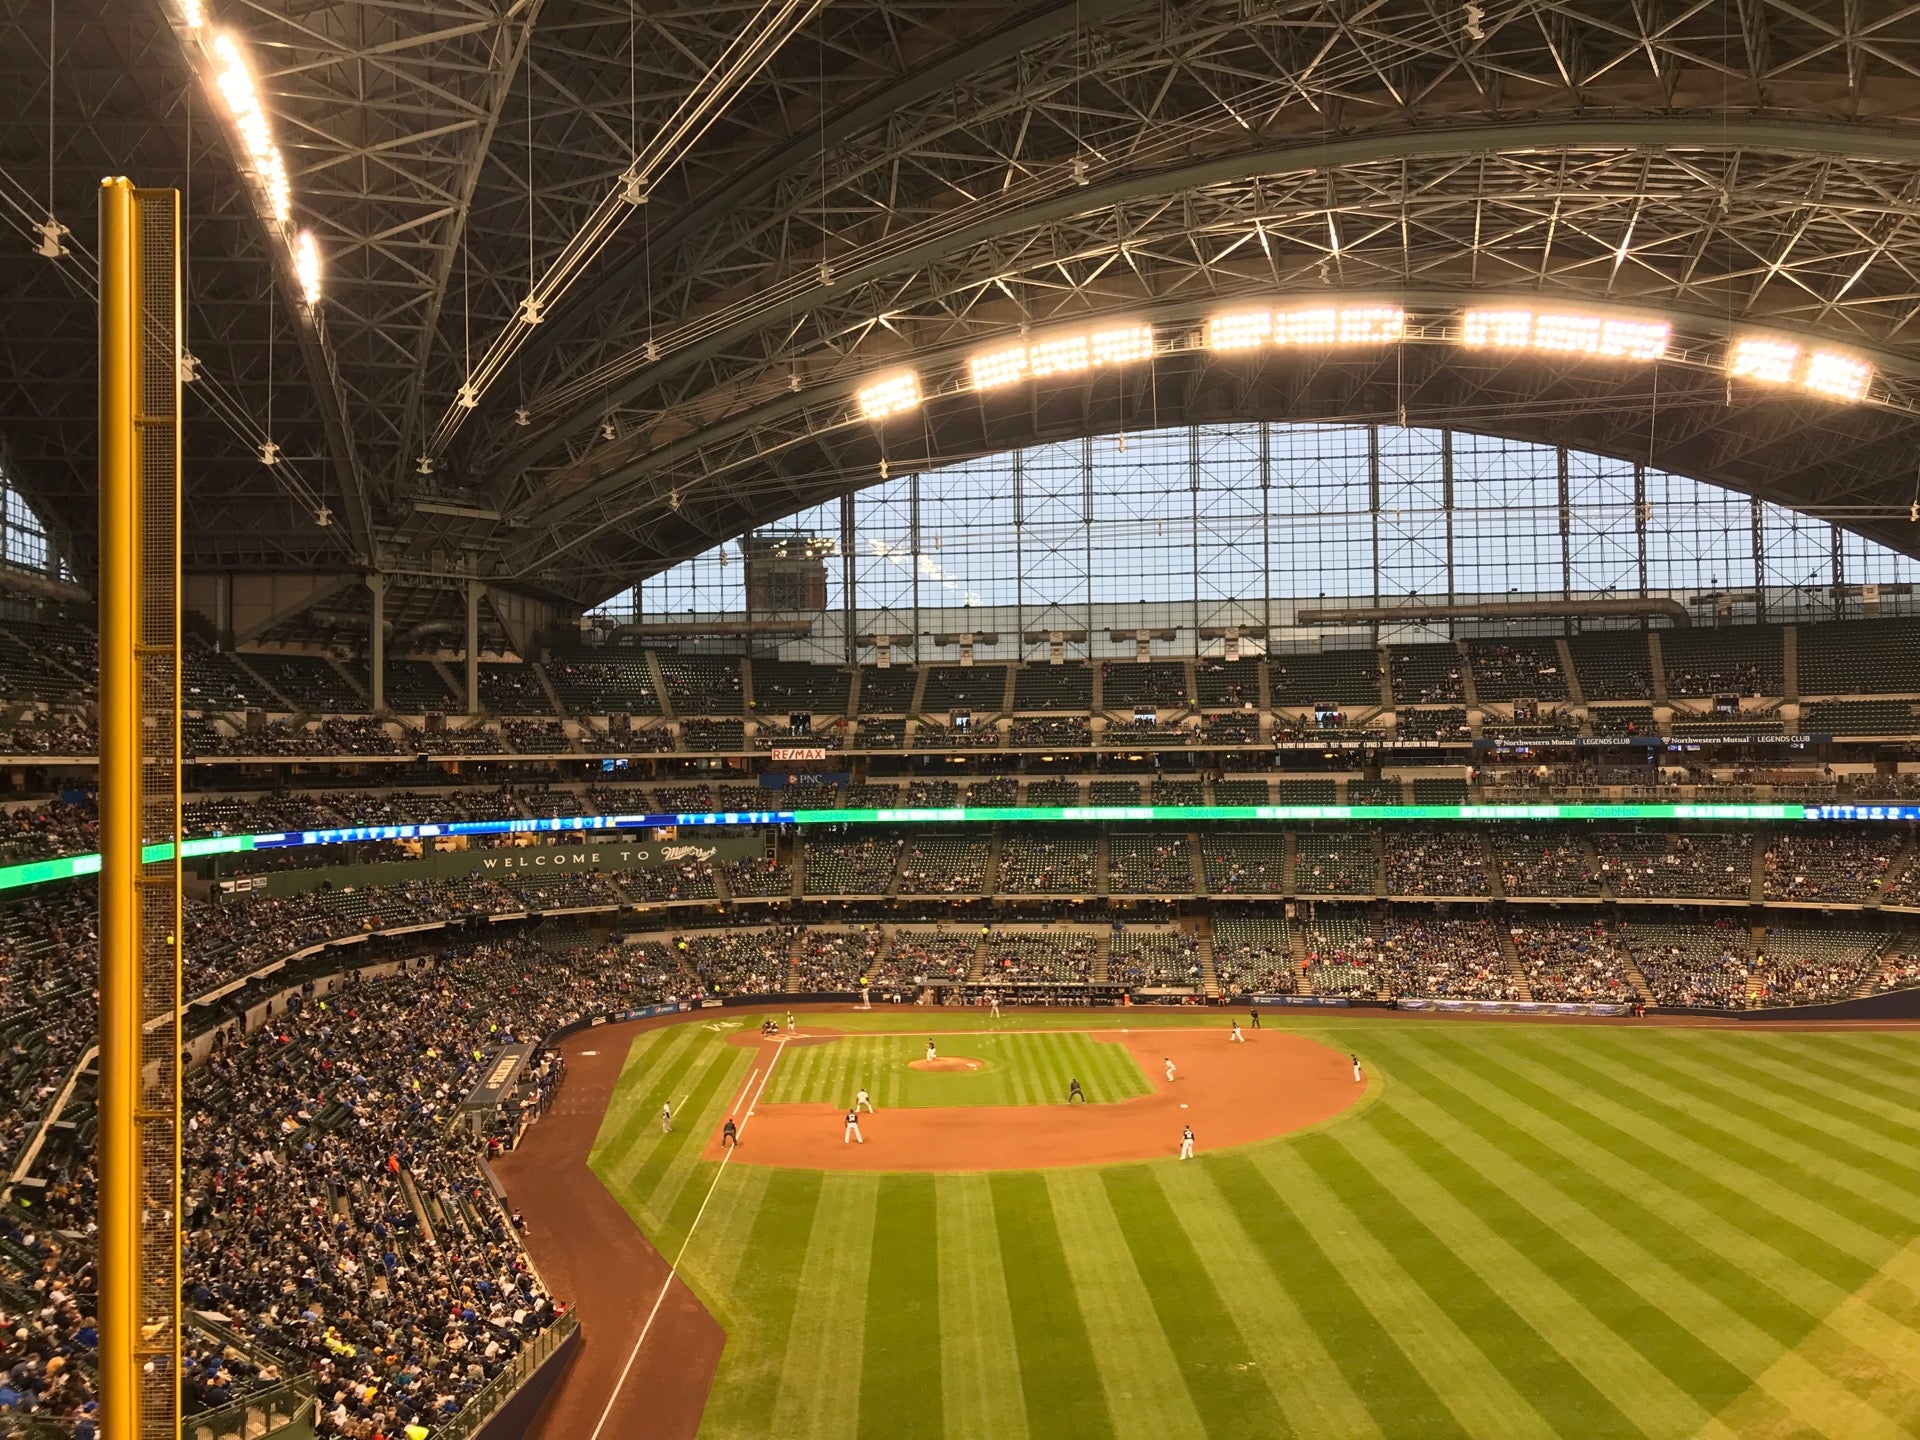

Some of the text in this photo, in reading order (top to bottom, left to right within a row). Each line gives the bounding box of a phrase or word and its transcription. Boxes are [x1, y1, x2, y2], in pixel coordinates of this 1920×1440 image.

[1671, 736, 1721, 744] Northwestern
[772, 750, 823, 759] RE/MAX
[800, 774, 822, 783] PNC
[1184, 808, 1225, 817] StubHub
[1383, 807, 1427, 817] StubHub
[1593, 806, 1638, 816] StubHub
[809, 811, 849, 821] StubHub
[483, 853, 599, 868] WELCOME
[621, 851, 649, 861] TO
[661, 845, 695, 862] Miller
